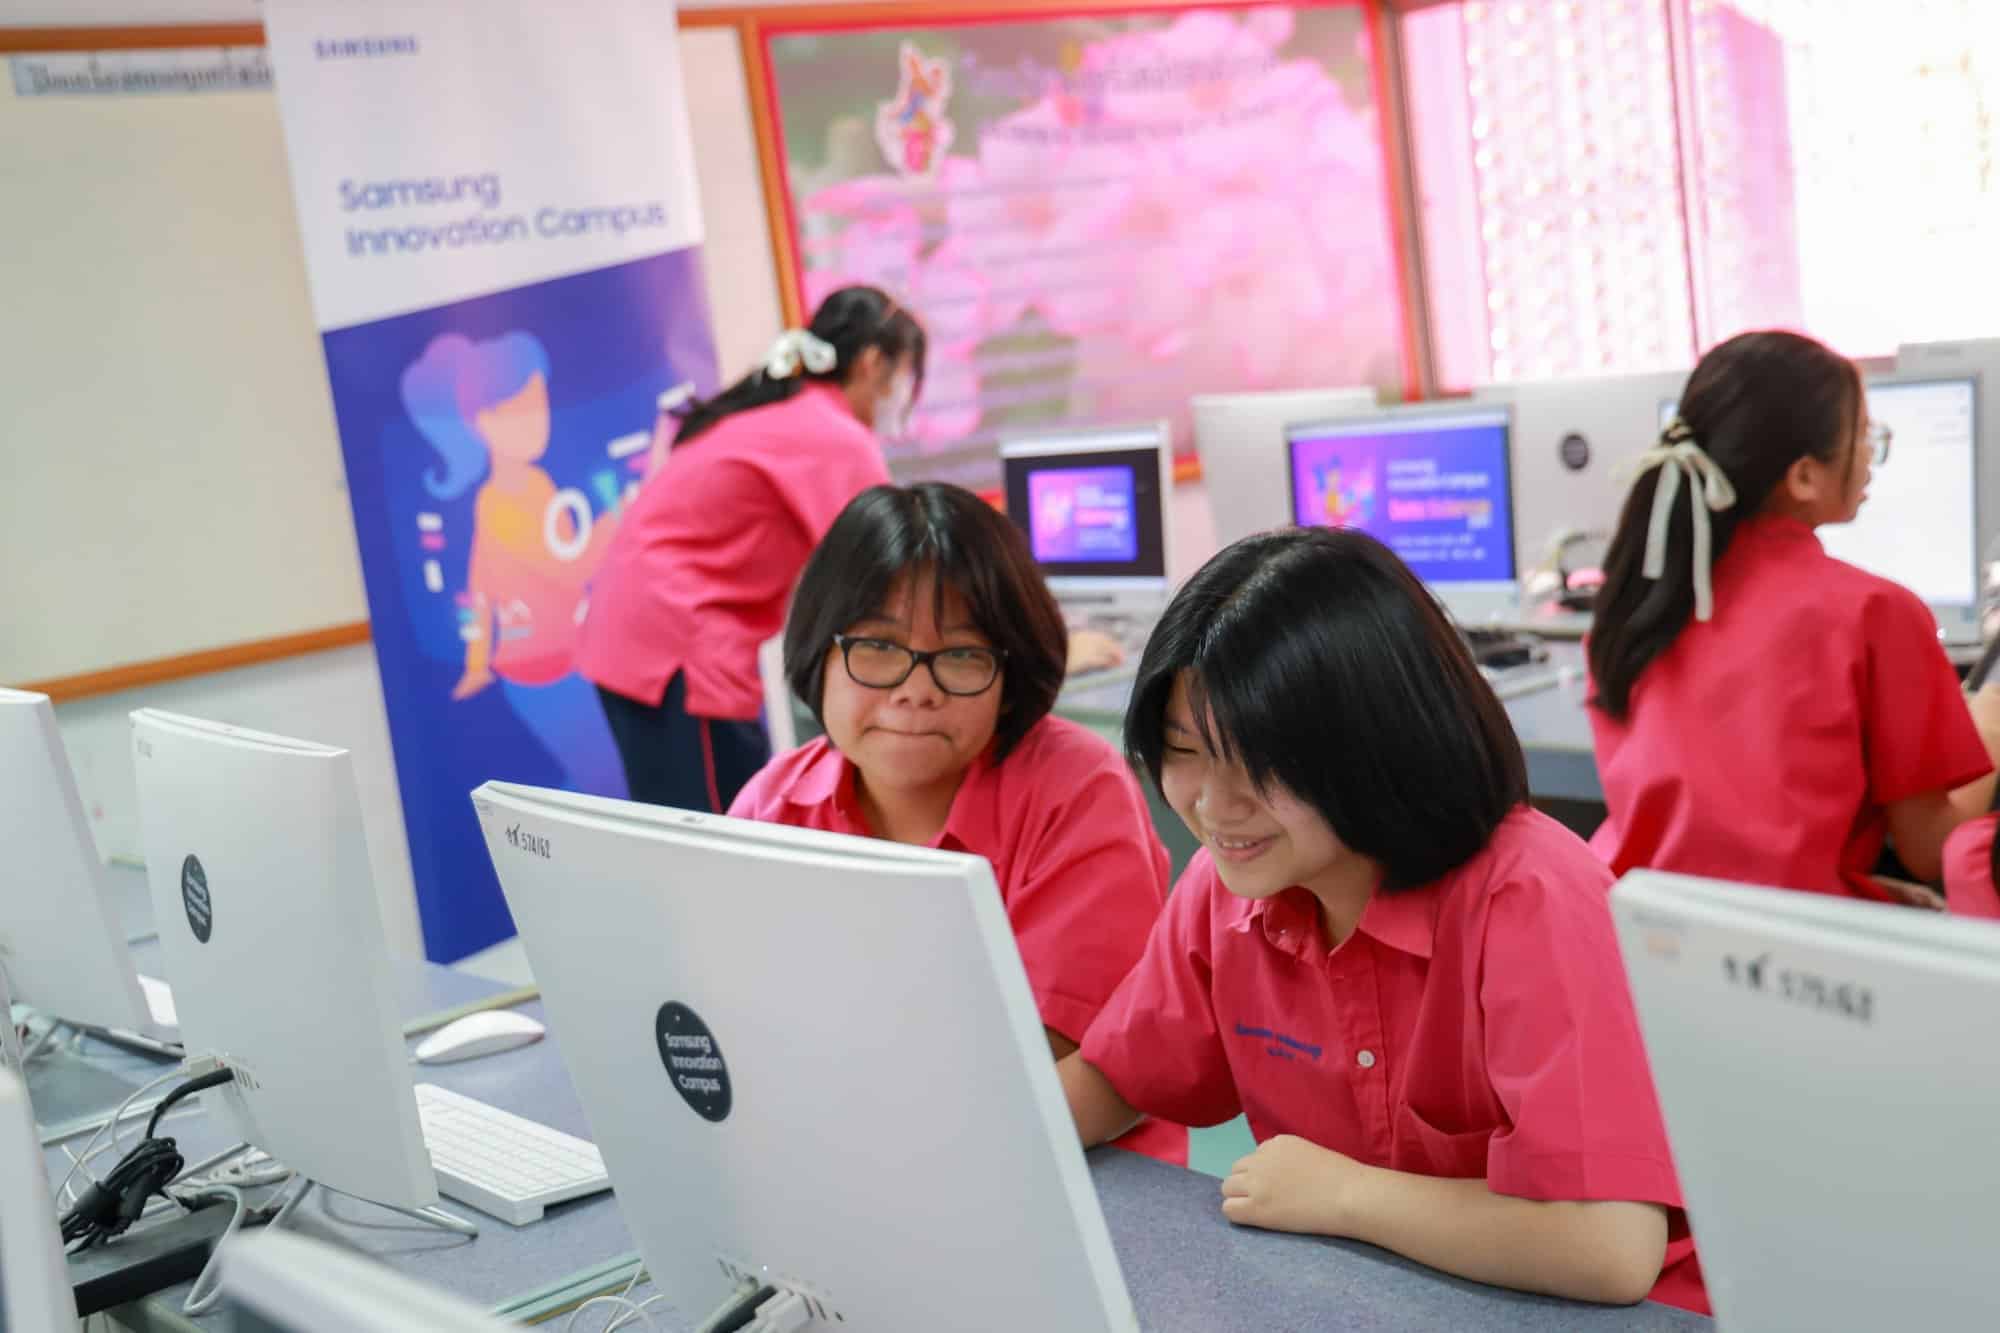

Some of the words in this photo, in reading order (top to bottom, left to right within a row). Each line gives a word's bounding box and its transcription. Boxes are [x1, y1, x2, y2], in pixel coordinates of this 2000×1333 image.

[339, 173, 500, 211] Samsung
[347, 214, 529, 256] Innovation
[534, 203, 666, 238] Campus
[664, 1032, 712, 1054] Samsung
[671, 1054, 722, 1070] Innovation
[679, 1074, 721, 1096] Campus
